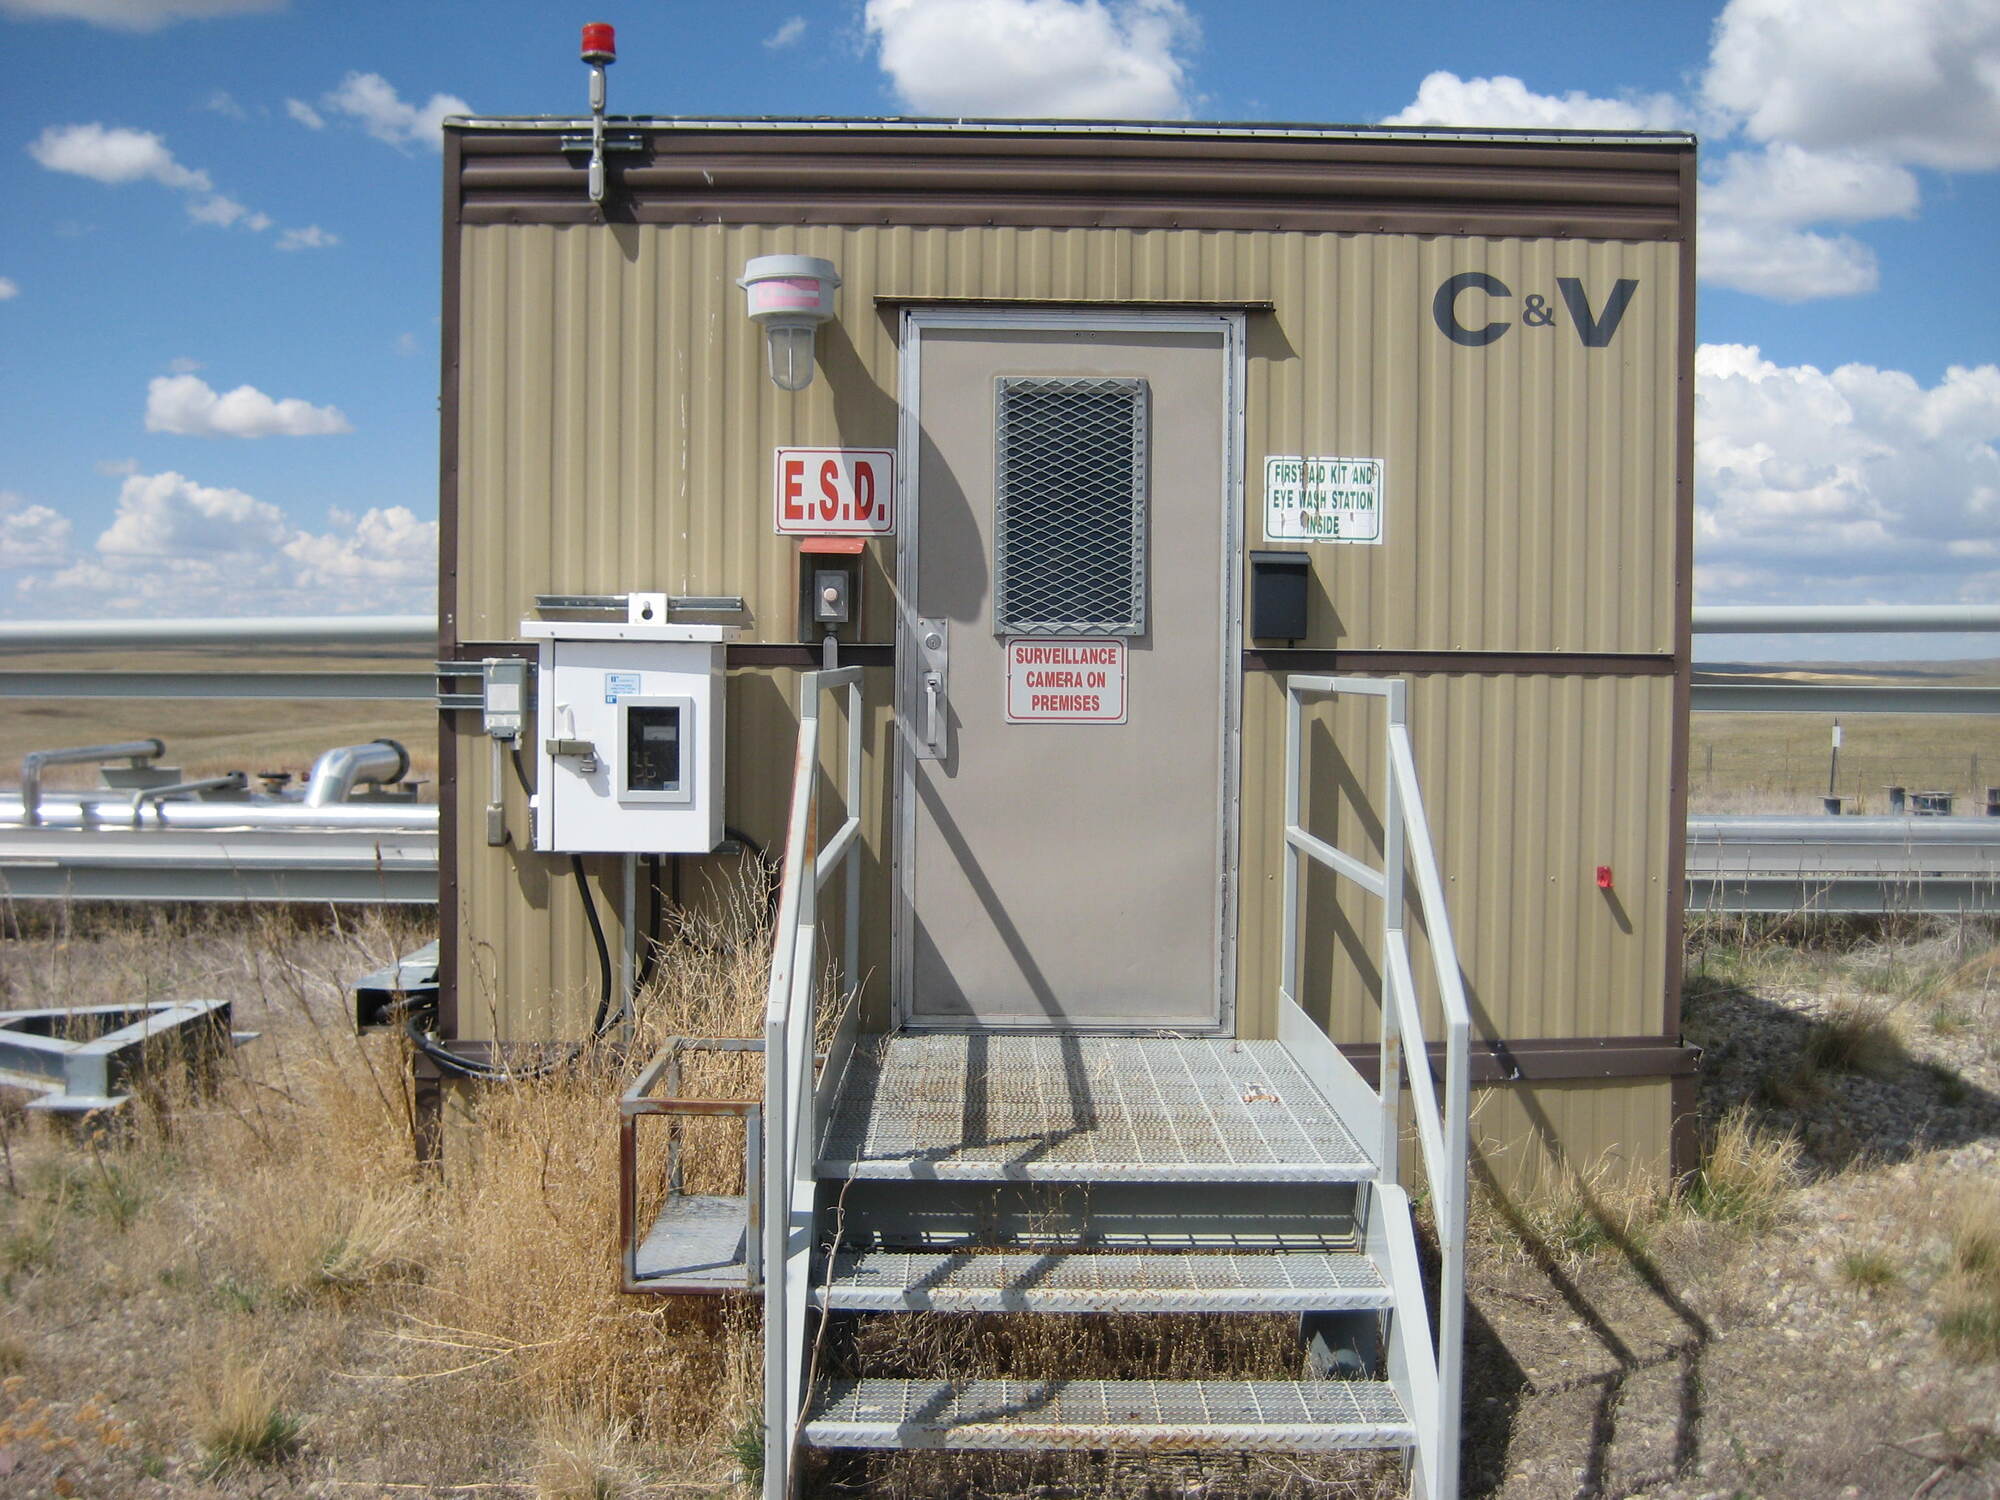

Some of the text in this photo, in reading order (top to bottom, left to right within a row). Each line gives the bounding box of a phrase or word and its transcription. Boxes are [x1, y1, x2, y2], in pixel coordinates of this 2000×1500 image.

[1275, 464, 1372, 485] FIRST AID KIT AND
[784, 459, 885, 521] E.S.D.
[1273, 489, 1373, 510] EYE WASH STATION
[1306, 515, 1339, 535] INSIDE
[1016, 647, 1117, 665] SURVEILLANCE
[1026, 671, 1106, 688] CAMERA ON
[1031, 695, 1100, 711] PREMISES
